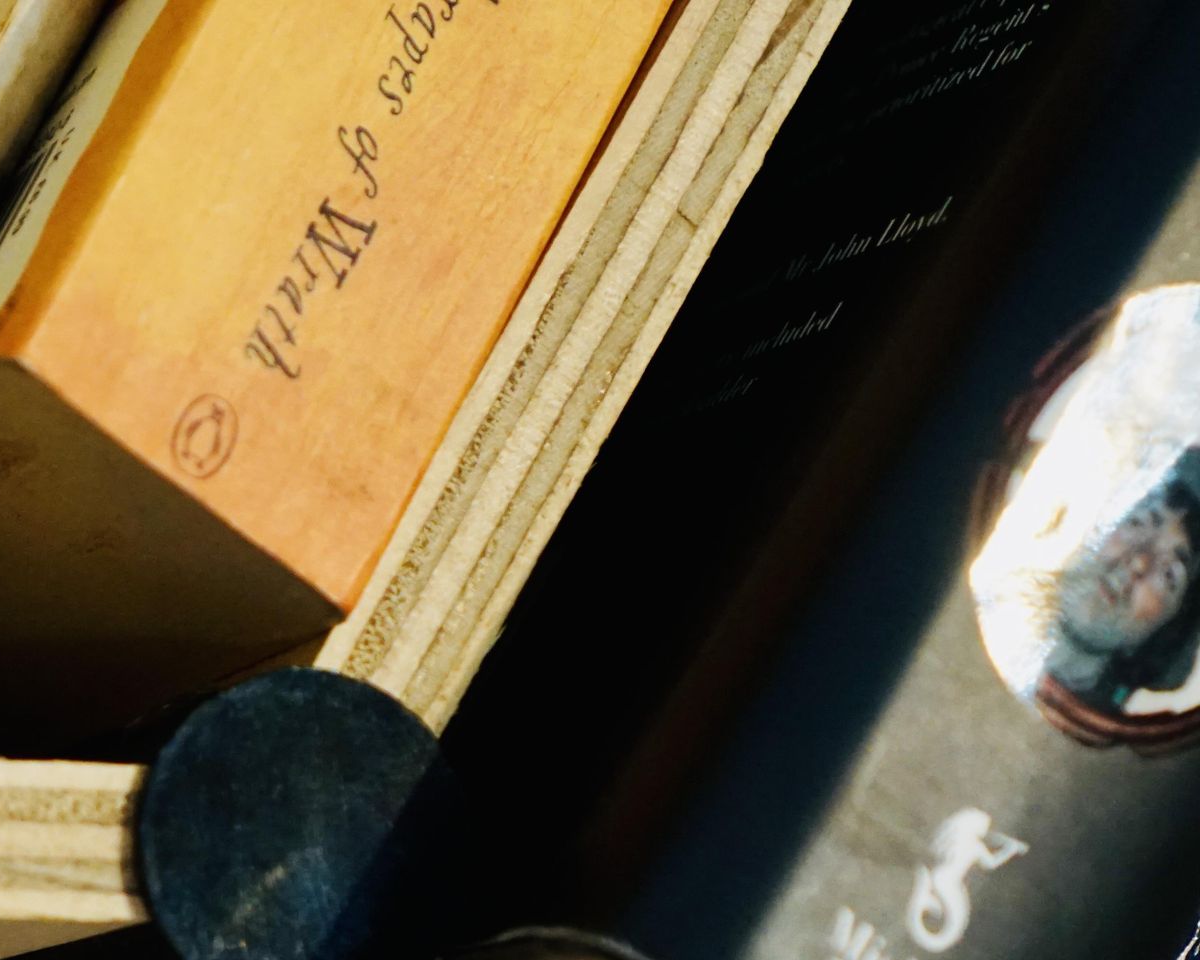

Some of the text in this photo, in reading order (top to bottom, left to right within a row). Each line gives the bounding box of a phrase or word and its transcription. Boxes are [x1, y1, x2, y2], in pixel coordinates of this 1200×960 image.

[244, 0, 498, 380] rapes of Wrath
